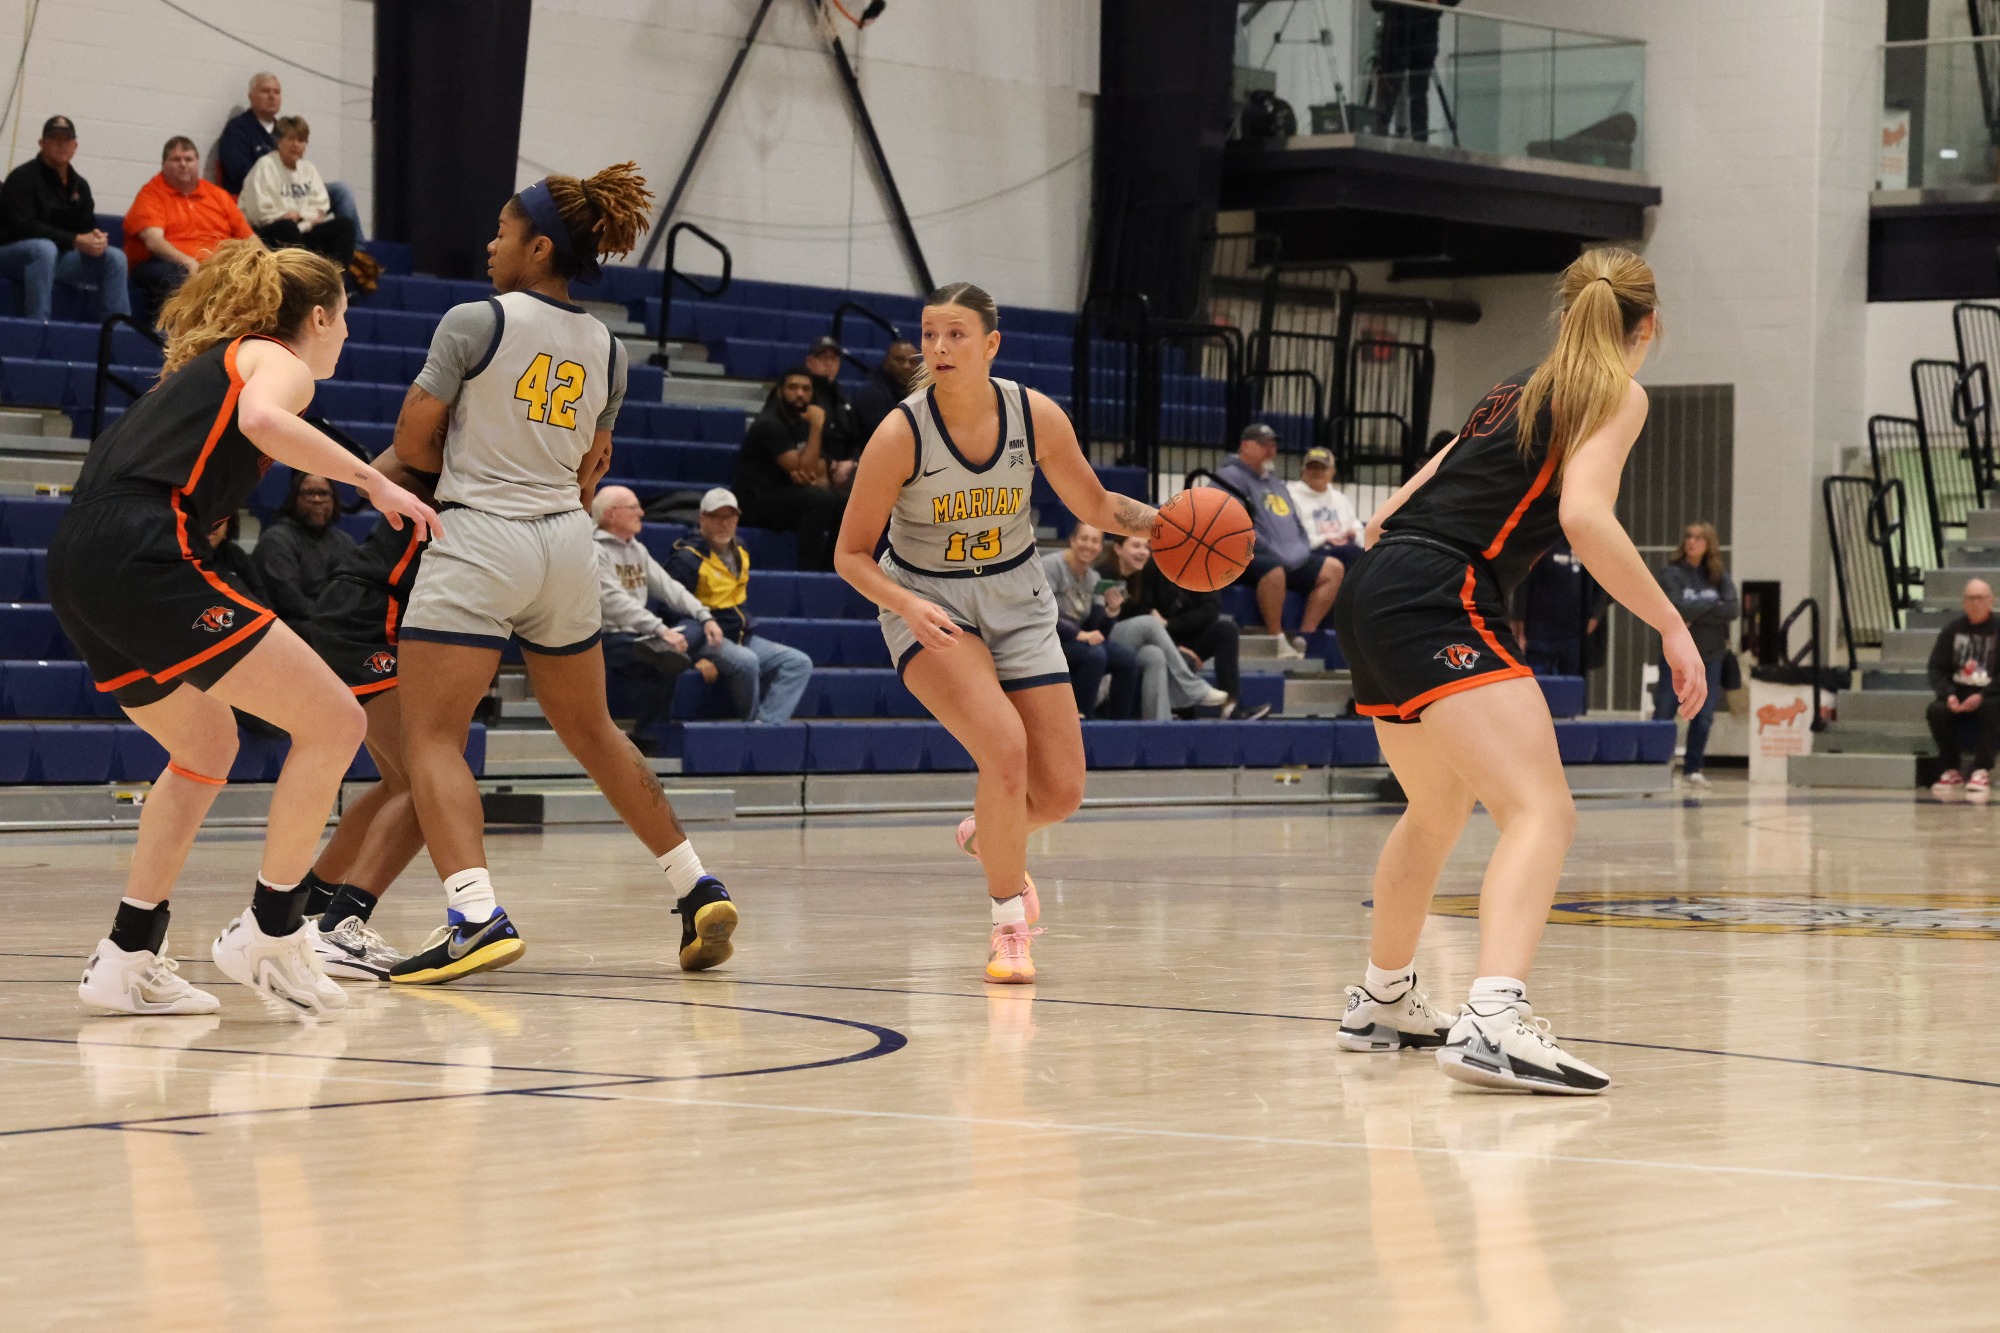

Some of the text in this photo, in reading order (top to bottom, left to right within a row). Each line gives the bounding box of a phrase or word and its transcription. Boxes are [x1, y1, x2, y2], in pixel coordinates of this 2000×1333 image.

[514, 352, 587, 431] 42
[932, 487, 1023, 524] MARIAN
[944, 526, 1002, 562] 13
